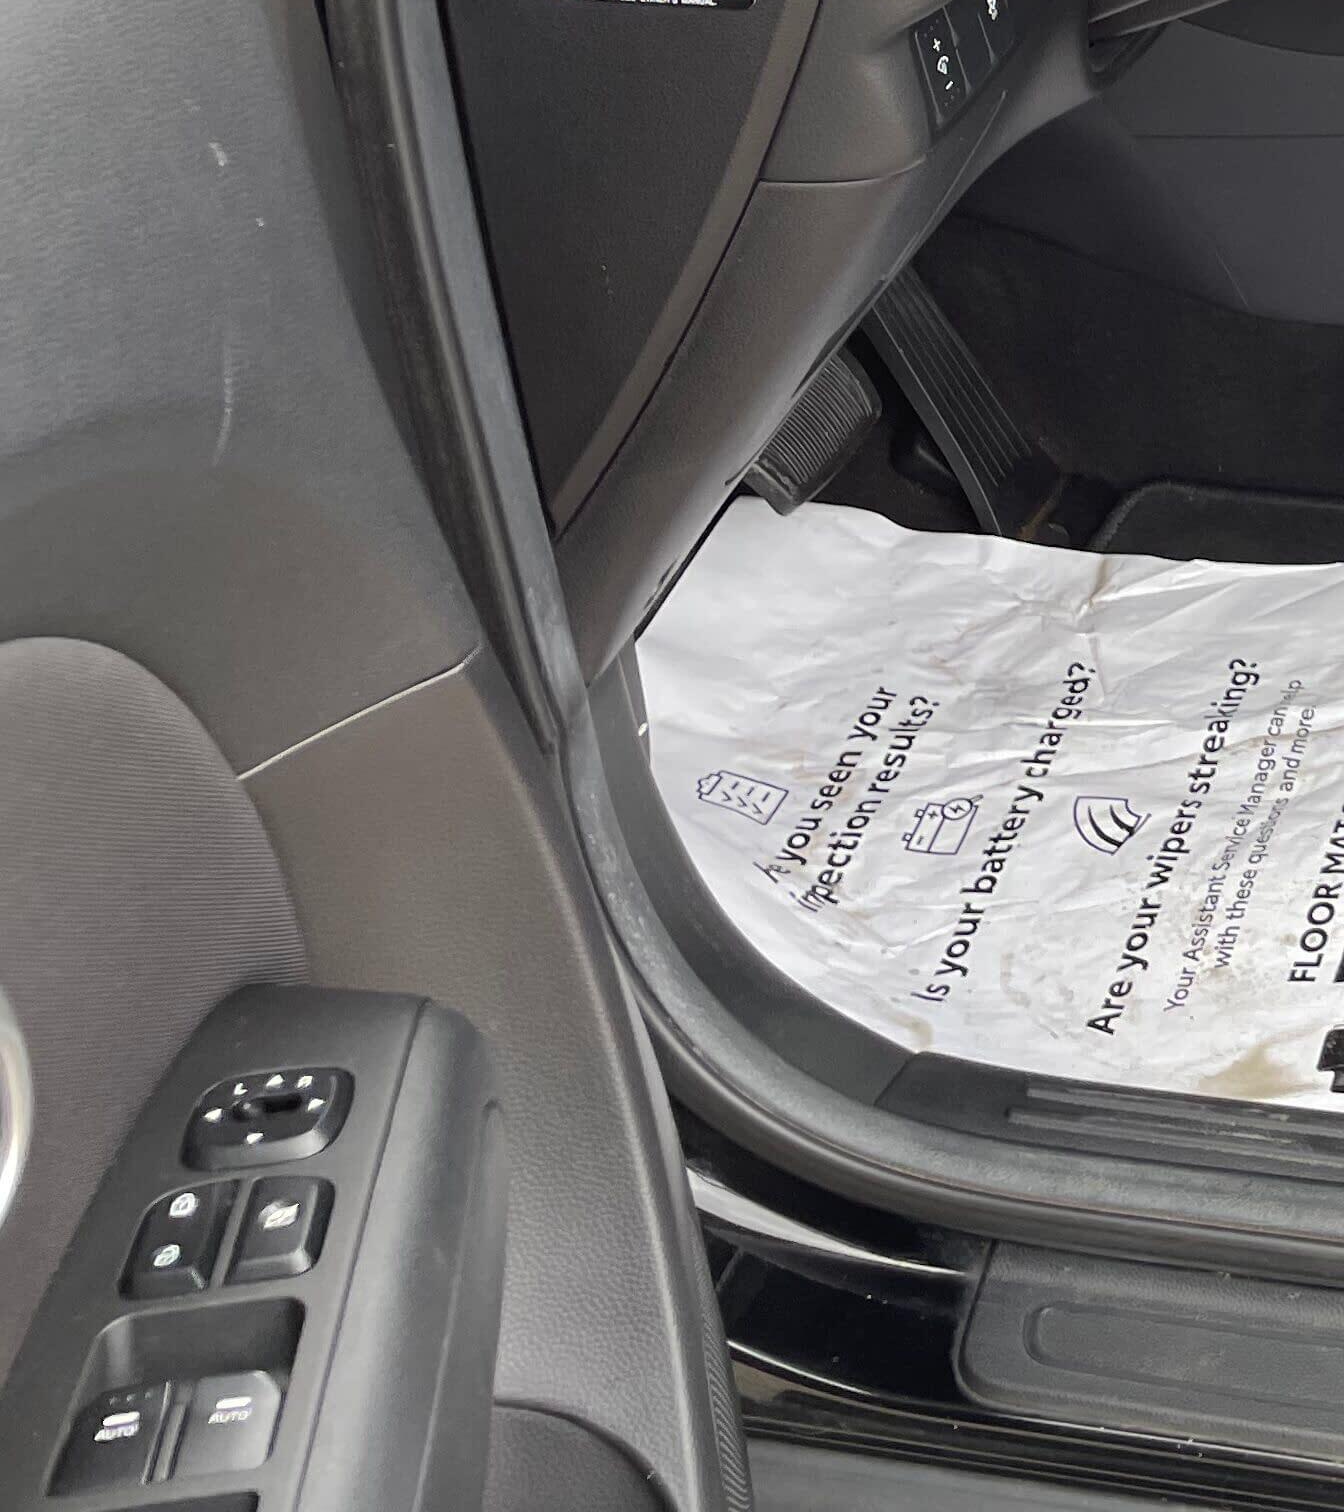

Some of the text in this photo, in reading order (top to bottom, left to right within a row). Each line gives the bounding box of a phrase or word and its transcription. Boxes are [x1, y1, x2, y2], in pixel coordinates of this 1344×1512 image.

[776, 685, 899, 866] you seen your
[868, 697, 940, 791] results?
[1278, 756, 1301, 792] and
[910, 660, 1096, 1001] Is your battery charged?
[1086, 655, 1258, 1034] Are your wipers streaking?
[1164, 967, 1195, 1011] Your
[1184, 872, 1226, 962] Assistant
[1212, 815, 1251, 869] Service
[1265, 704, 1289, 737] can
[1226, 867, 1259, 919] these
[1287, 876, 1343, 982] FLOOR
[1212, 923, 1241, 966] with
[94, 1423, 139, 1442] AUTO
[208, 1407, 251, 1424] AUTO
